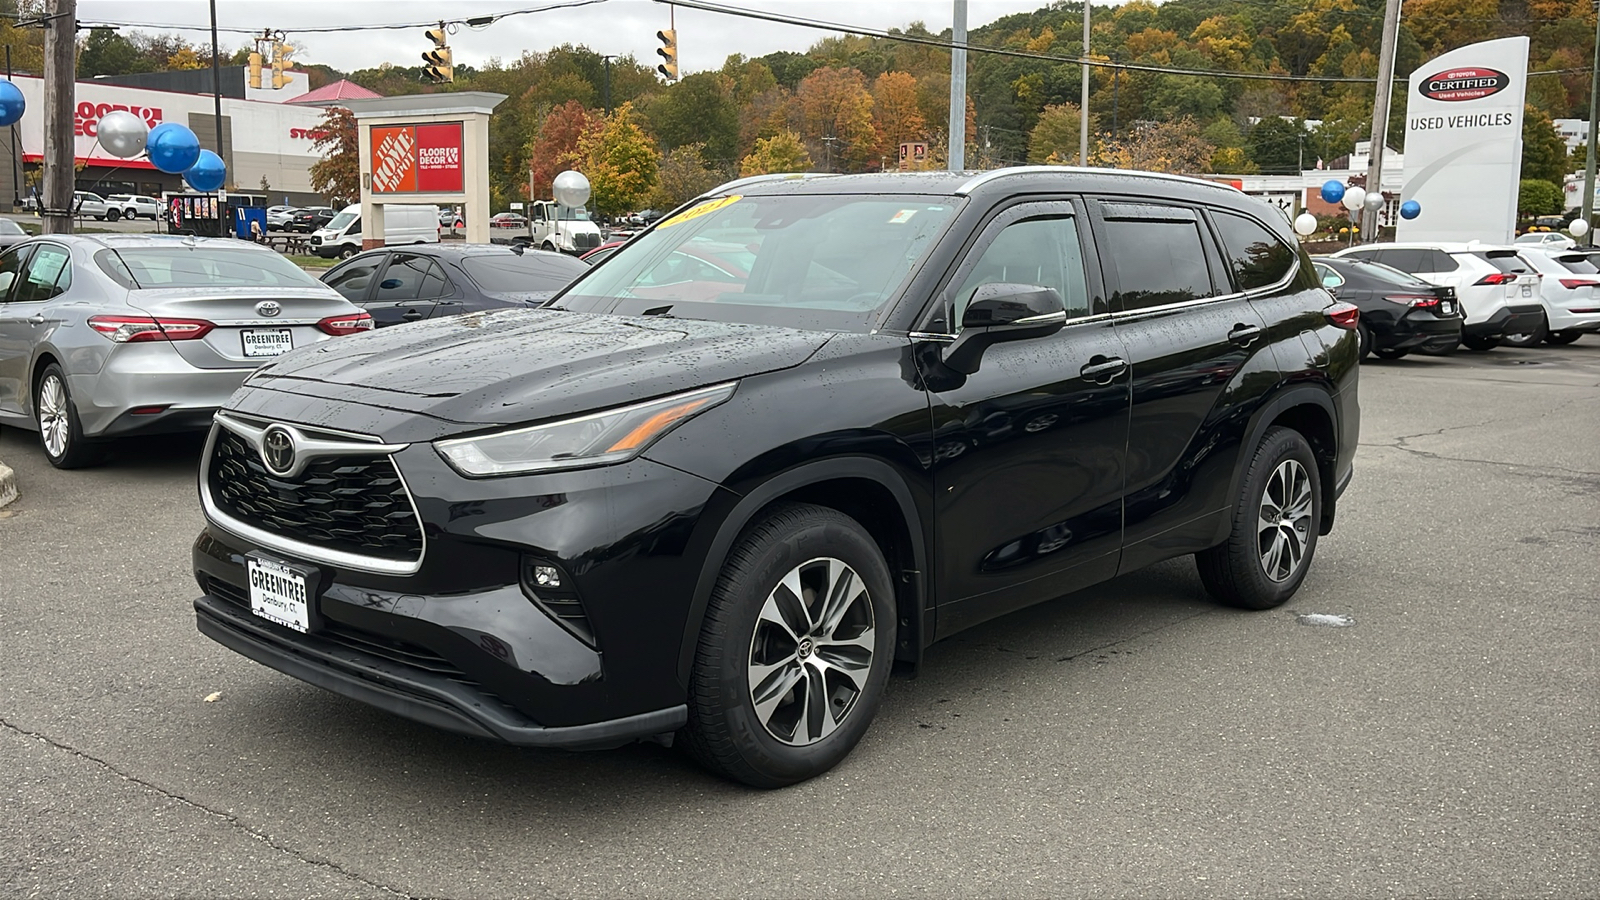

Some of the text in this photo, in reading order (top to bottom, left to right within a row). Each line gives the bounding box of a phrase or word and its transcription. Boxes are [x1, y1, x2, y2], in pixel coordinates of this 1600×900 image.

[1429, 78, 1498, 91] CERTIFIED
[1457, 90, 1485, 98] Vehicles
[1411, 113, 1512, 130] USED VEHICLES
[290, 128, 330, 140] STO
[375, 132, 396, 160] THE
[419, 148, 445, 157] FLOOR
[373, 128, 415, 192] HOME
[419, 156, 446, 164] DECOR
[388, 150, 415, 192] DEPOT
[245, 334, 290, 344] GREENTREE
[251, 568, 305, 604] GREENTREE
[262, 593, 288, 612] Danbury,
[252, 609, 307, 634] GREENTREE
